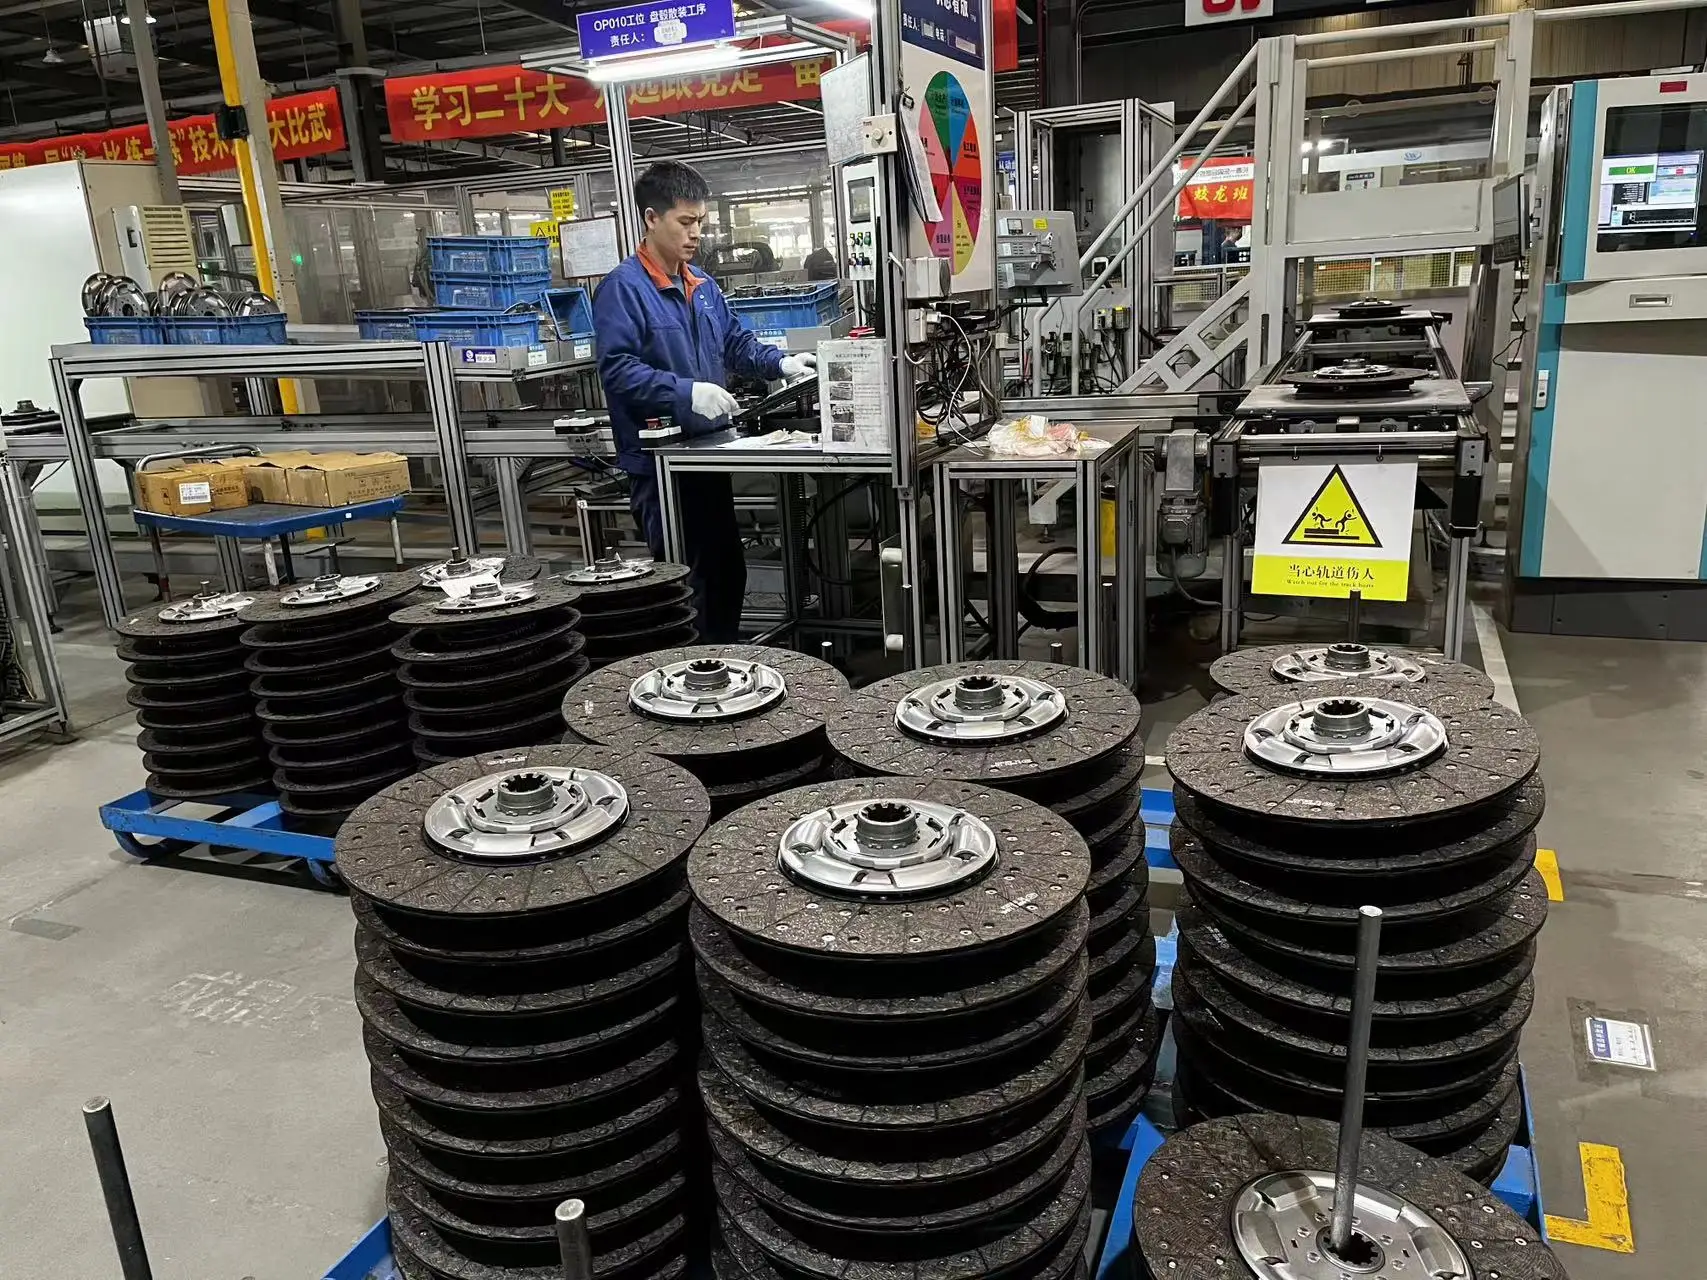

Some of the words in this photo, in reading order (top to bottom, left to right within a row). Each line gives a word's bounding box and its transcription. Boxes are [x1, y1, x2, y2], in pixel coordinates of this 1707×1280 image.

[593, 13, 646, 32] OP010工位
[410, 73, 570, 131] 学习二十大
[1626, 166, 1637, 175] OK
[1288, 563, 1375, 580] 当心轨道伤人
